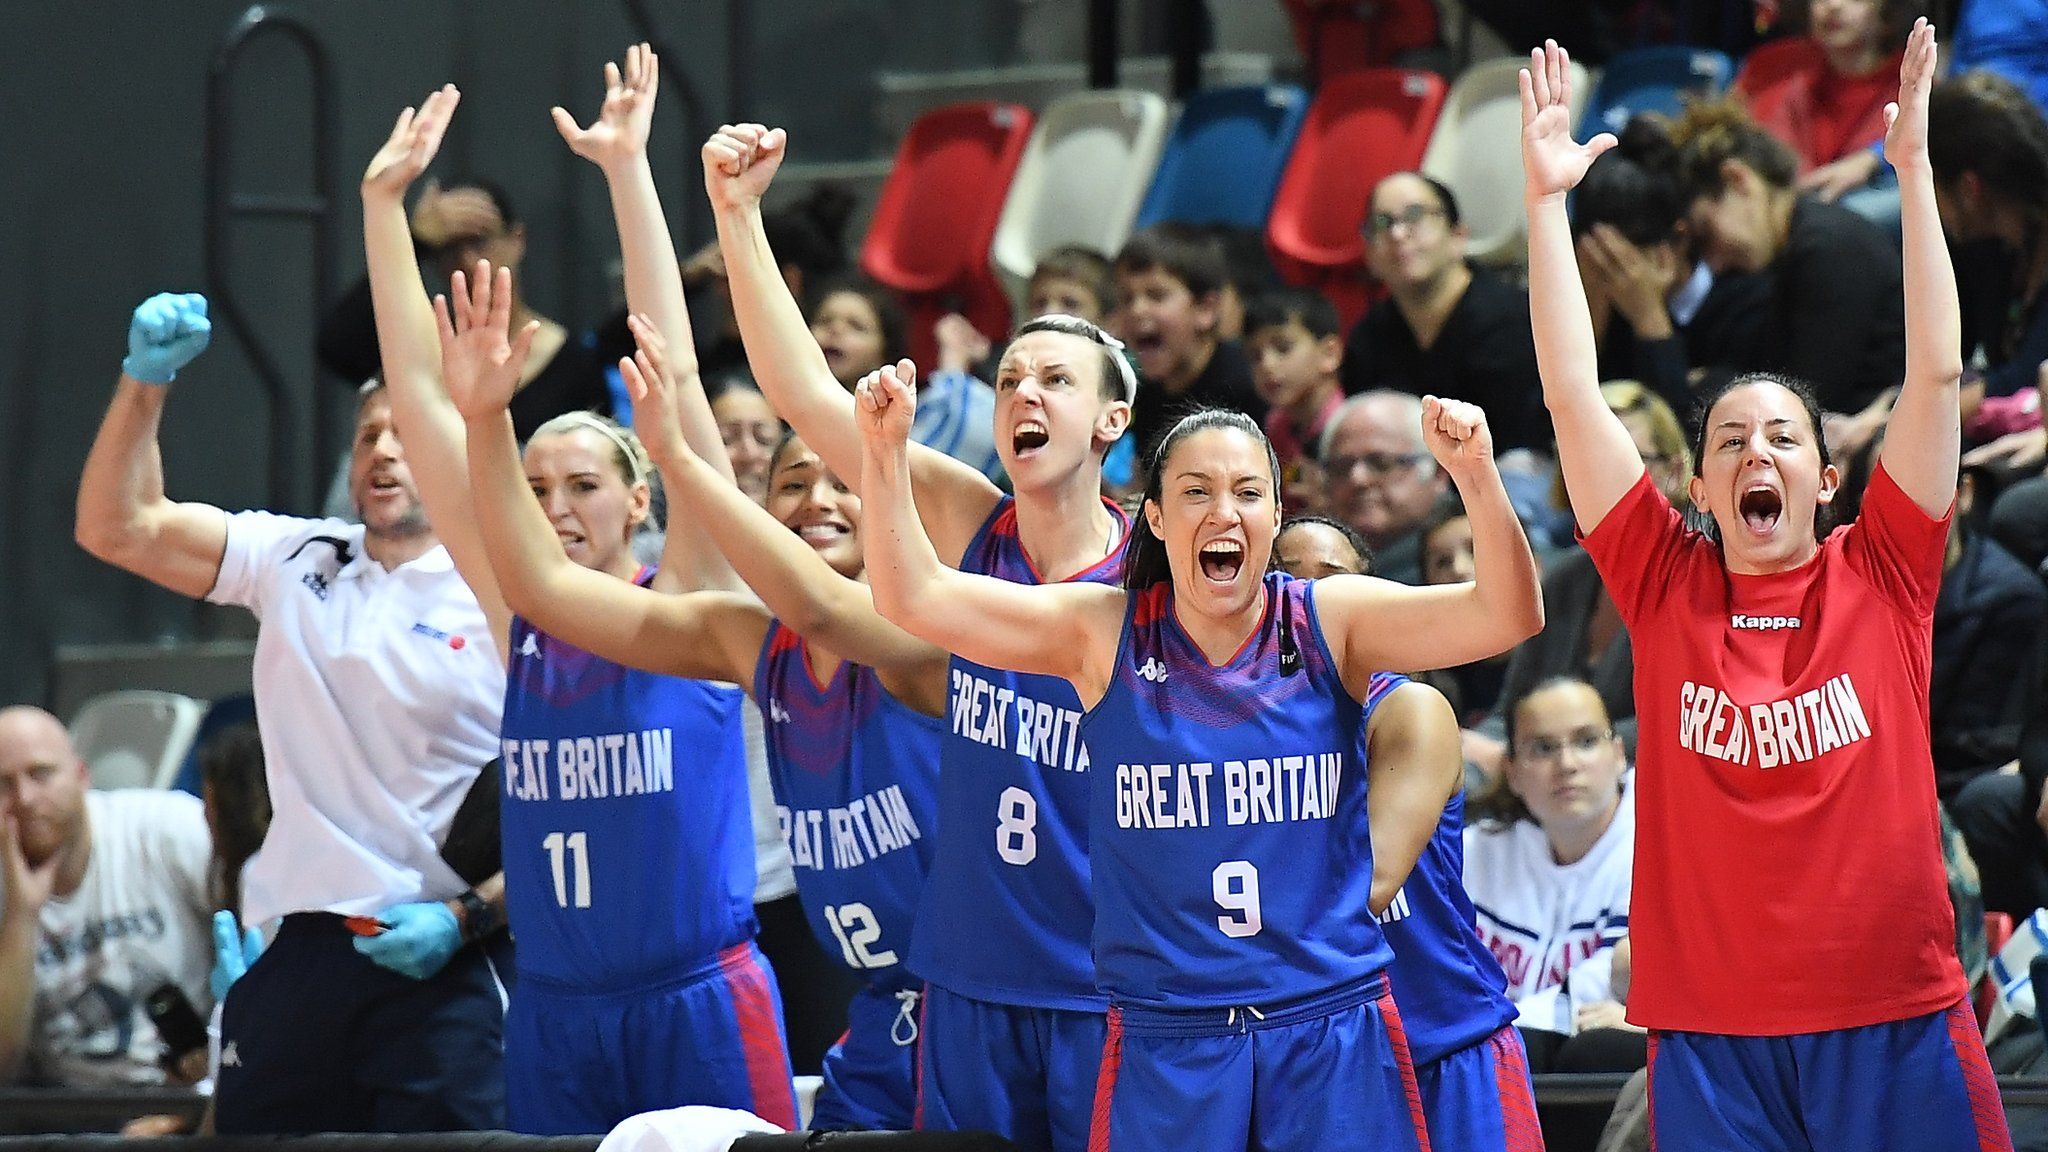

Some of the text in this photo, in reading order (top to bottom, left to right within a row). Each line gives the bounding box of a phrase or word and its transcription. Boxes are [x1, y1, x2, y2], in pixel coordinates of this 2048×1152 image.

[1731, 614, 1801, 631] Kappa
[1015, 695, 1092, 772] BRITA
[1750, 673, 1872, 769] BRITAIN
[502, 727, 674, 801] EAT BRITAIN
[1116, 751, 1342, 829] GREAT BRITAIN
[776, 783, 921, 870] RAT RTAIN
[996, 785, 1037, 866] 8
[542, 831, 591, 909] 11
[1212, 860, 1262, 938] 9
[824, 902, 898, 969] 12
